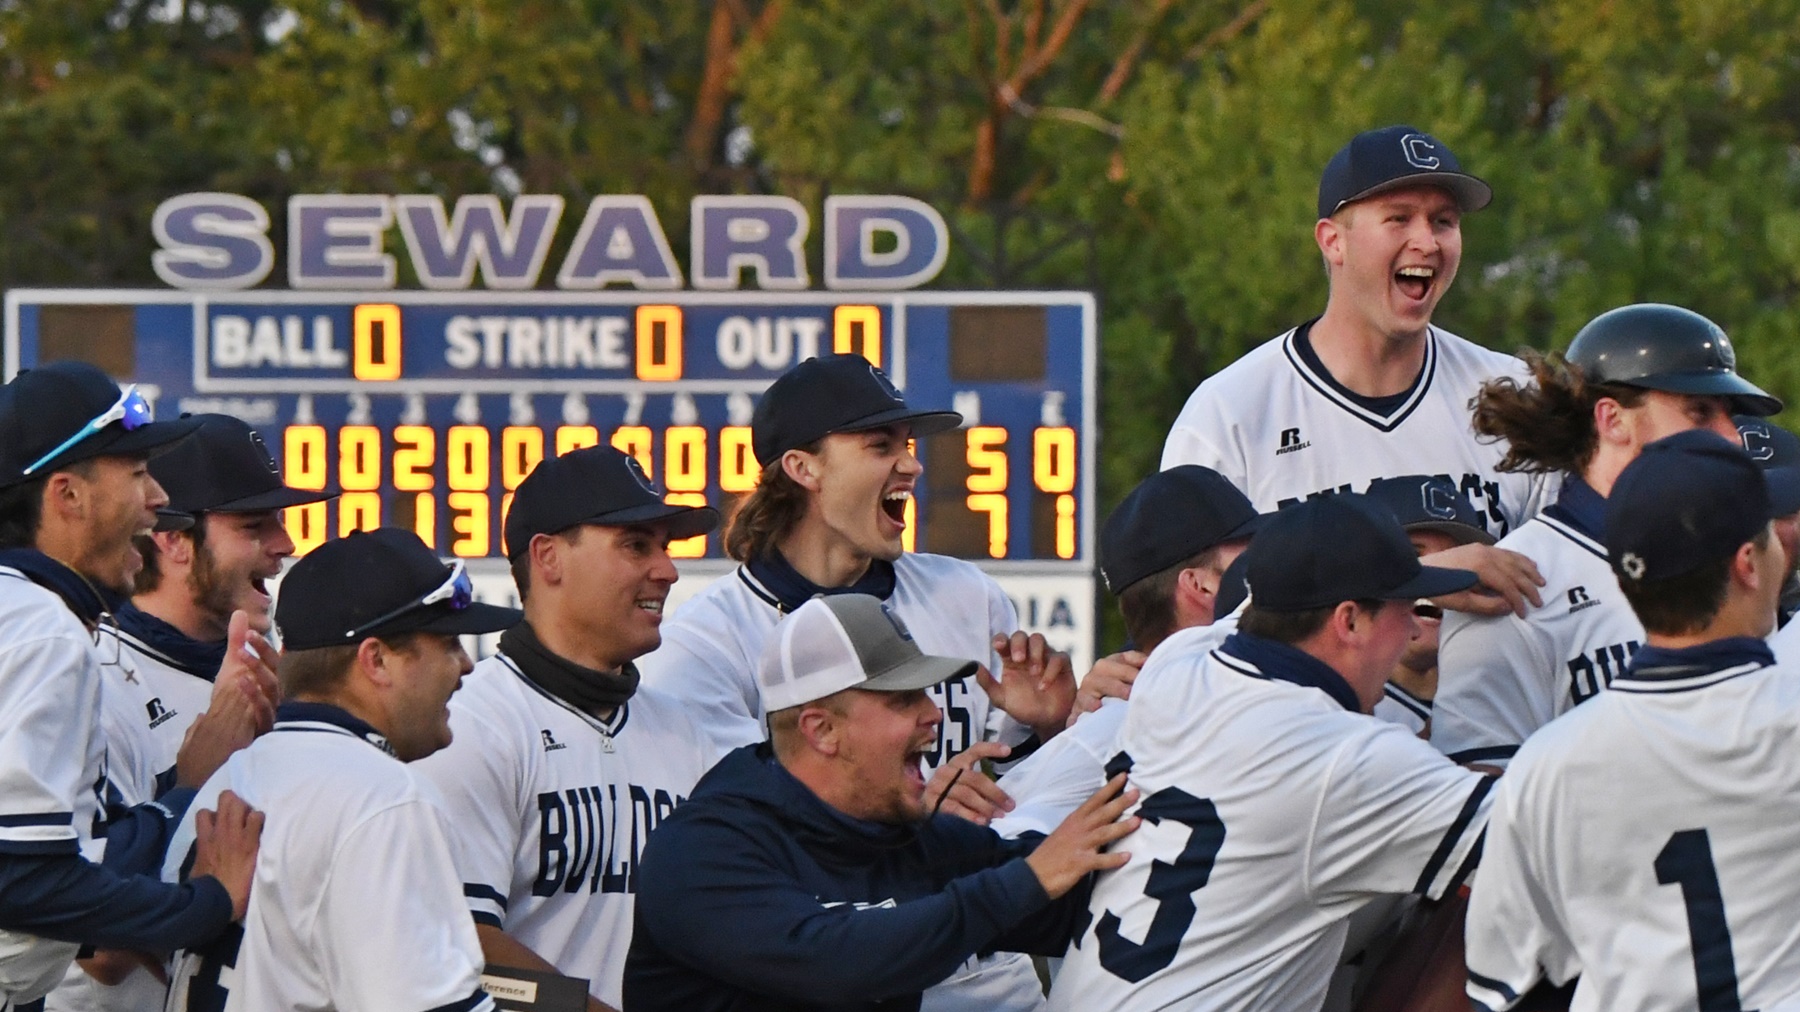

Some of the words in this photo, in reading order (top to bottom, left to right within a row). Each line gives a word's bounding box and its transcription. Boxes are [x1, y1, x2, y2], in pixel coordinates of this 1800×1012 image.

[1401, 133, 1440, 170] C
[151, 191, 950, 290] SEWARD
[213, 316, 347, 369] BALL
[353, 304, 402, 381] 0
[444, 317, 630, 369] STRIKE
[636, 305, 683, 381] 0
[716, 317, 825, 370] OUT
[966, 426, 1008, 492] 5
[1033, 426, 1075, 493] 0
[1275, 440, 1312, 455] RUSSELL
[966, 493, 1008, 559] 7
[1056, 494, 1076, 560] 1
[1420, 480, 1457, 520] C
